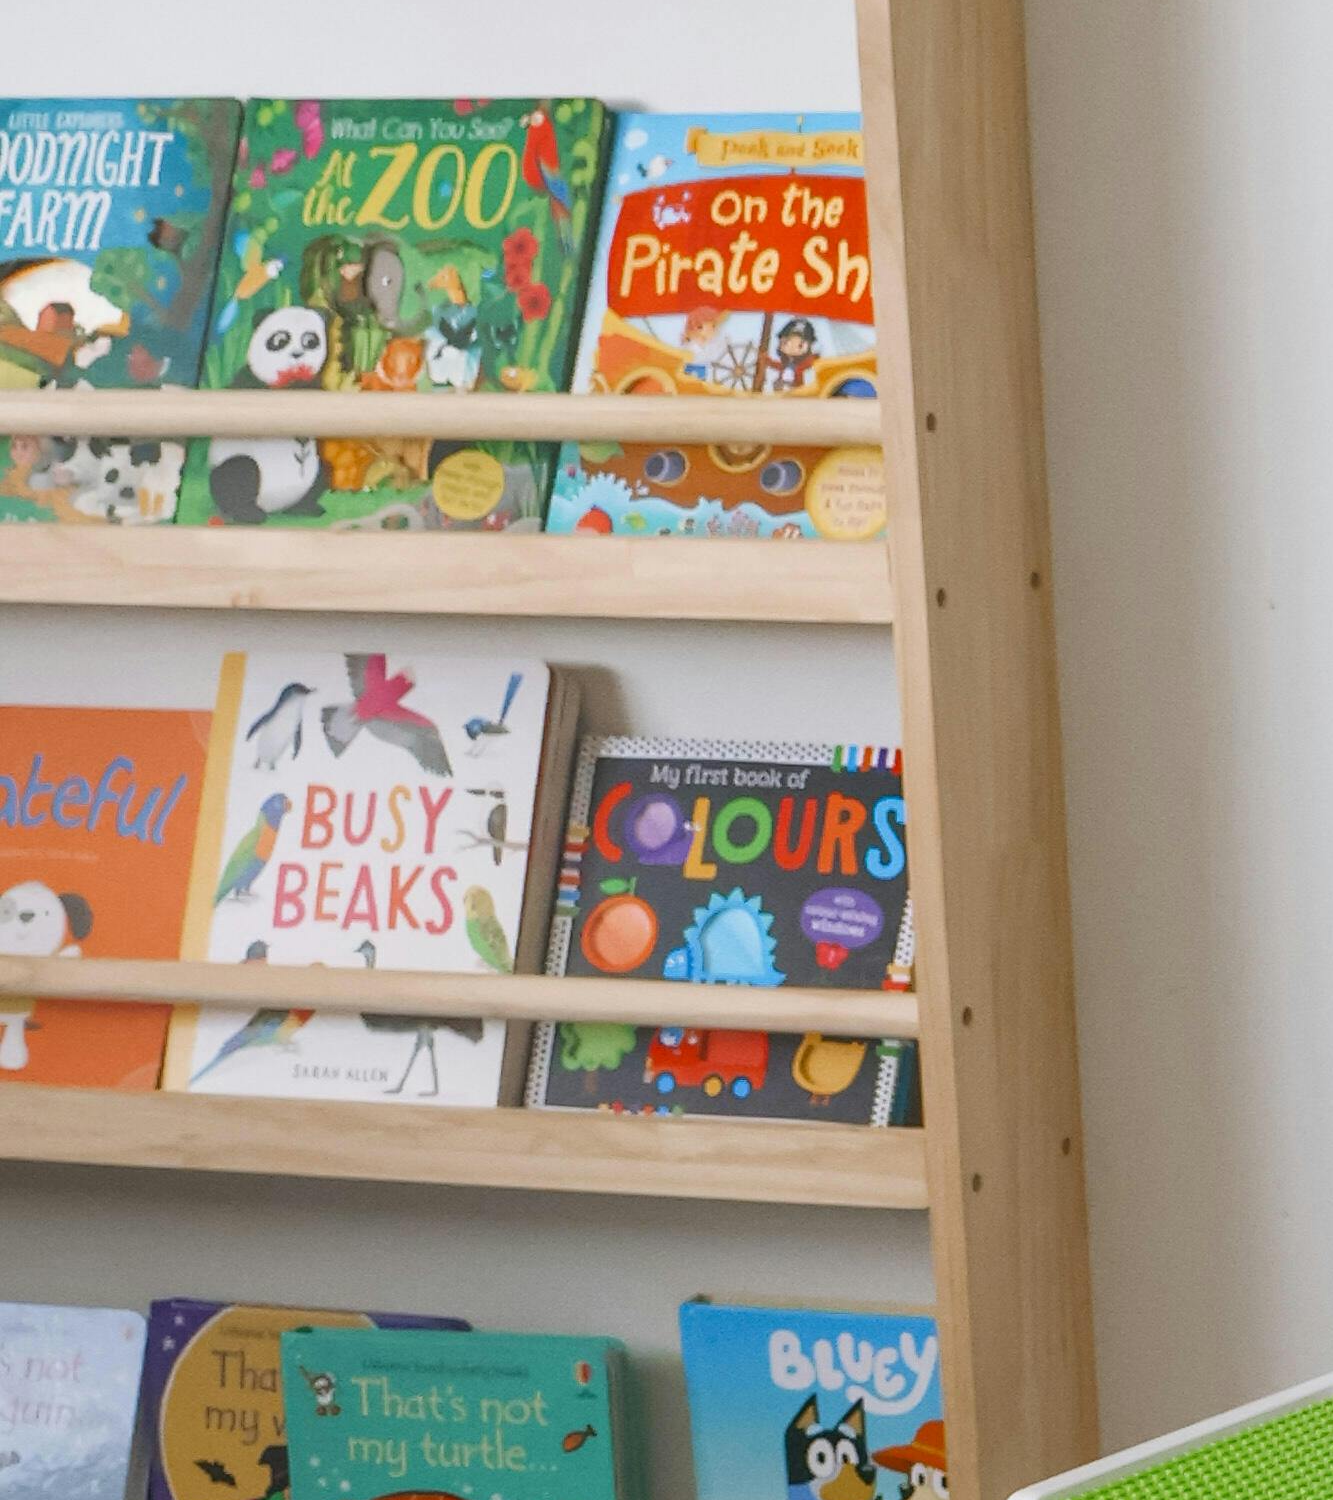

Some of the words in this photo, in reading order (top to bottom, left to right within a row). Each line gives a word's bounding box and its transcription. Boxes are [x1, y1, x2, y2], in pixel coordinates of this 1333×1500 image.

[331, 117, 377, 140] What
[382, 116, 423, 141] Can
[429, 117, 466, 141] You
[302, 184, 356, 227] the
[356, 141, 518, 231] ZOO
[315, 149, 357, 188] At
[711, 189, 768, 227] On
[781, 182, 844, 230] the
[619, 230, 781, 299] Pirate
[650, 764, 680, 790] My
[684, 763, 730, 787] first
[733, 766, 783, 789] book
[786, 768, 812, 791] of
[301, 783, 454, 855] BUSY
[593, 780, 906, 882] COLOURS
[273, 861, 458, 936] BEAKS
[206, 1405, 259, 1446] my
[351, 1376, 468, 1423] That's
[480, 1390, 548, 1427] not
[348, 1436, 407, 1478] my
